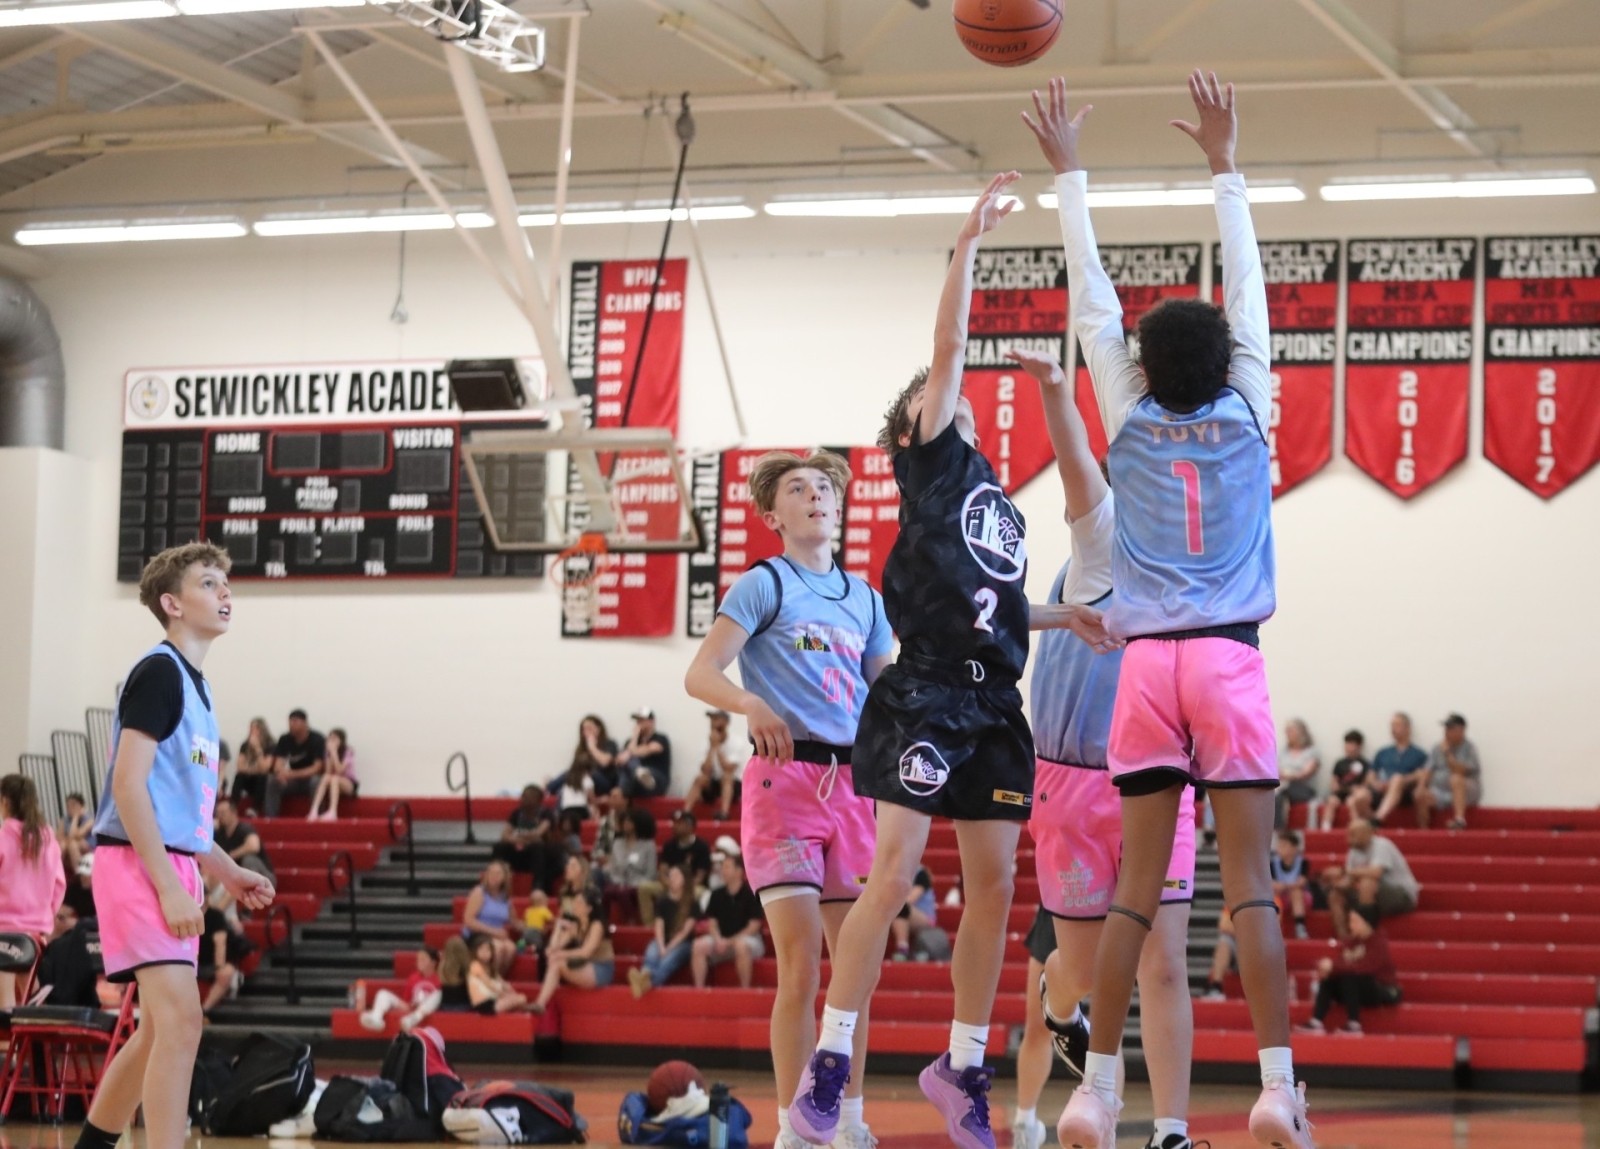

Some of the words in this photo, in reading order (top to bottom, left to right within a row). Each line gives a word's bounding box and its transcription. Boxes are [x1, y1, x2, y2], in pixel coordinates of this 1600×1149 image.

[1351, 242, 1476, 262] SEWICKLEY
[1360, 261, 1463, 281] ACADEMY
[1500, 259, 1598, 279] ACADEMY
[605, 292, 682, 312] CHAMPONS
[571, 266, 598, 378] BASKETBALL
[1347, 332, 1472, 360] CHAMPIONS
[175, 373, 340, 418] SEWICKLEY
[348, 370, 453, 412] ACADE
[1146, 422, 1221, 444] YUYI
[1396, 370, 1418, 486] 2016
[1536, 368, 1556, 483] 2017
[215, 432, 261, 452] HOME
[394, 428, 454, 448] VISITOR
[229, 497, 266, 512] BONUS
[389, 493, 428, 510] BONUS
[1171, 460, 1204, 556] 1
[322, 516, 365, 532] PLAYER
[973, 587, 998, 634] 2
